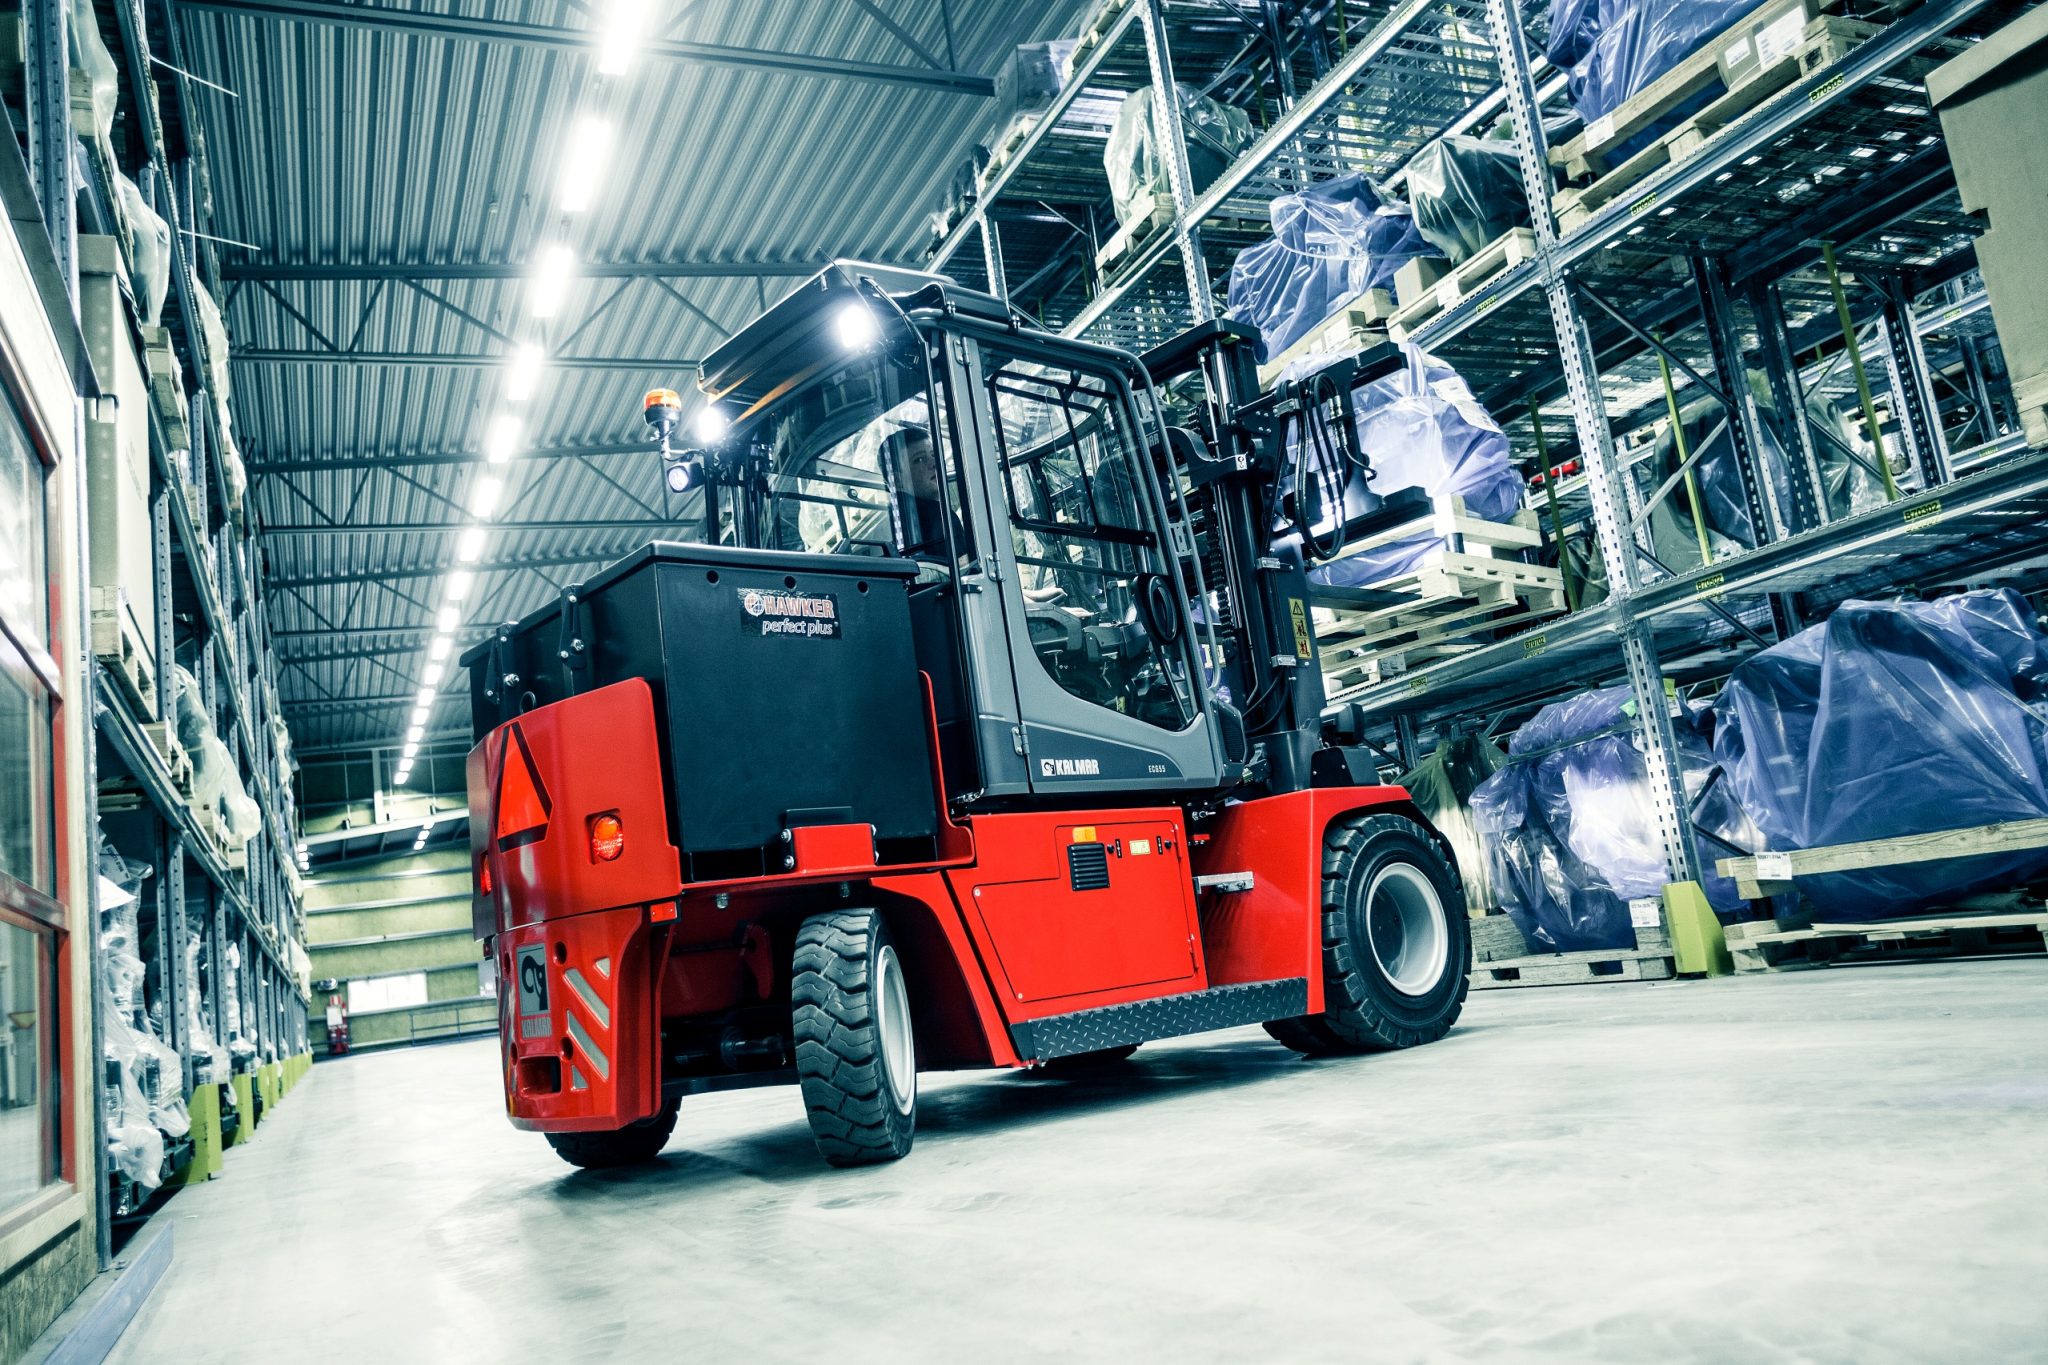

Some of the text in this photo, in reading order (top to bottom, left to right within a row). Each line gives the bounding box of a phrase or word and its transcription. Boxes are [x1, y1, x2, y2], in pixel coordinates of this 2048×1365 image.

[1811, 75, 1844, 100] B70303
[1904, 502, 1939, 520] B70302
[763, 595, 835, 618] HAWKER
[762, 618, 833, 637] perfect plus
[1055, 759, 1100, 775] KALMAR
